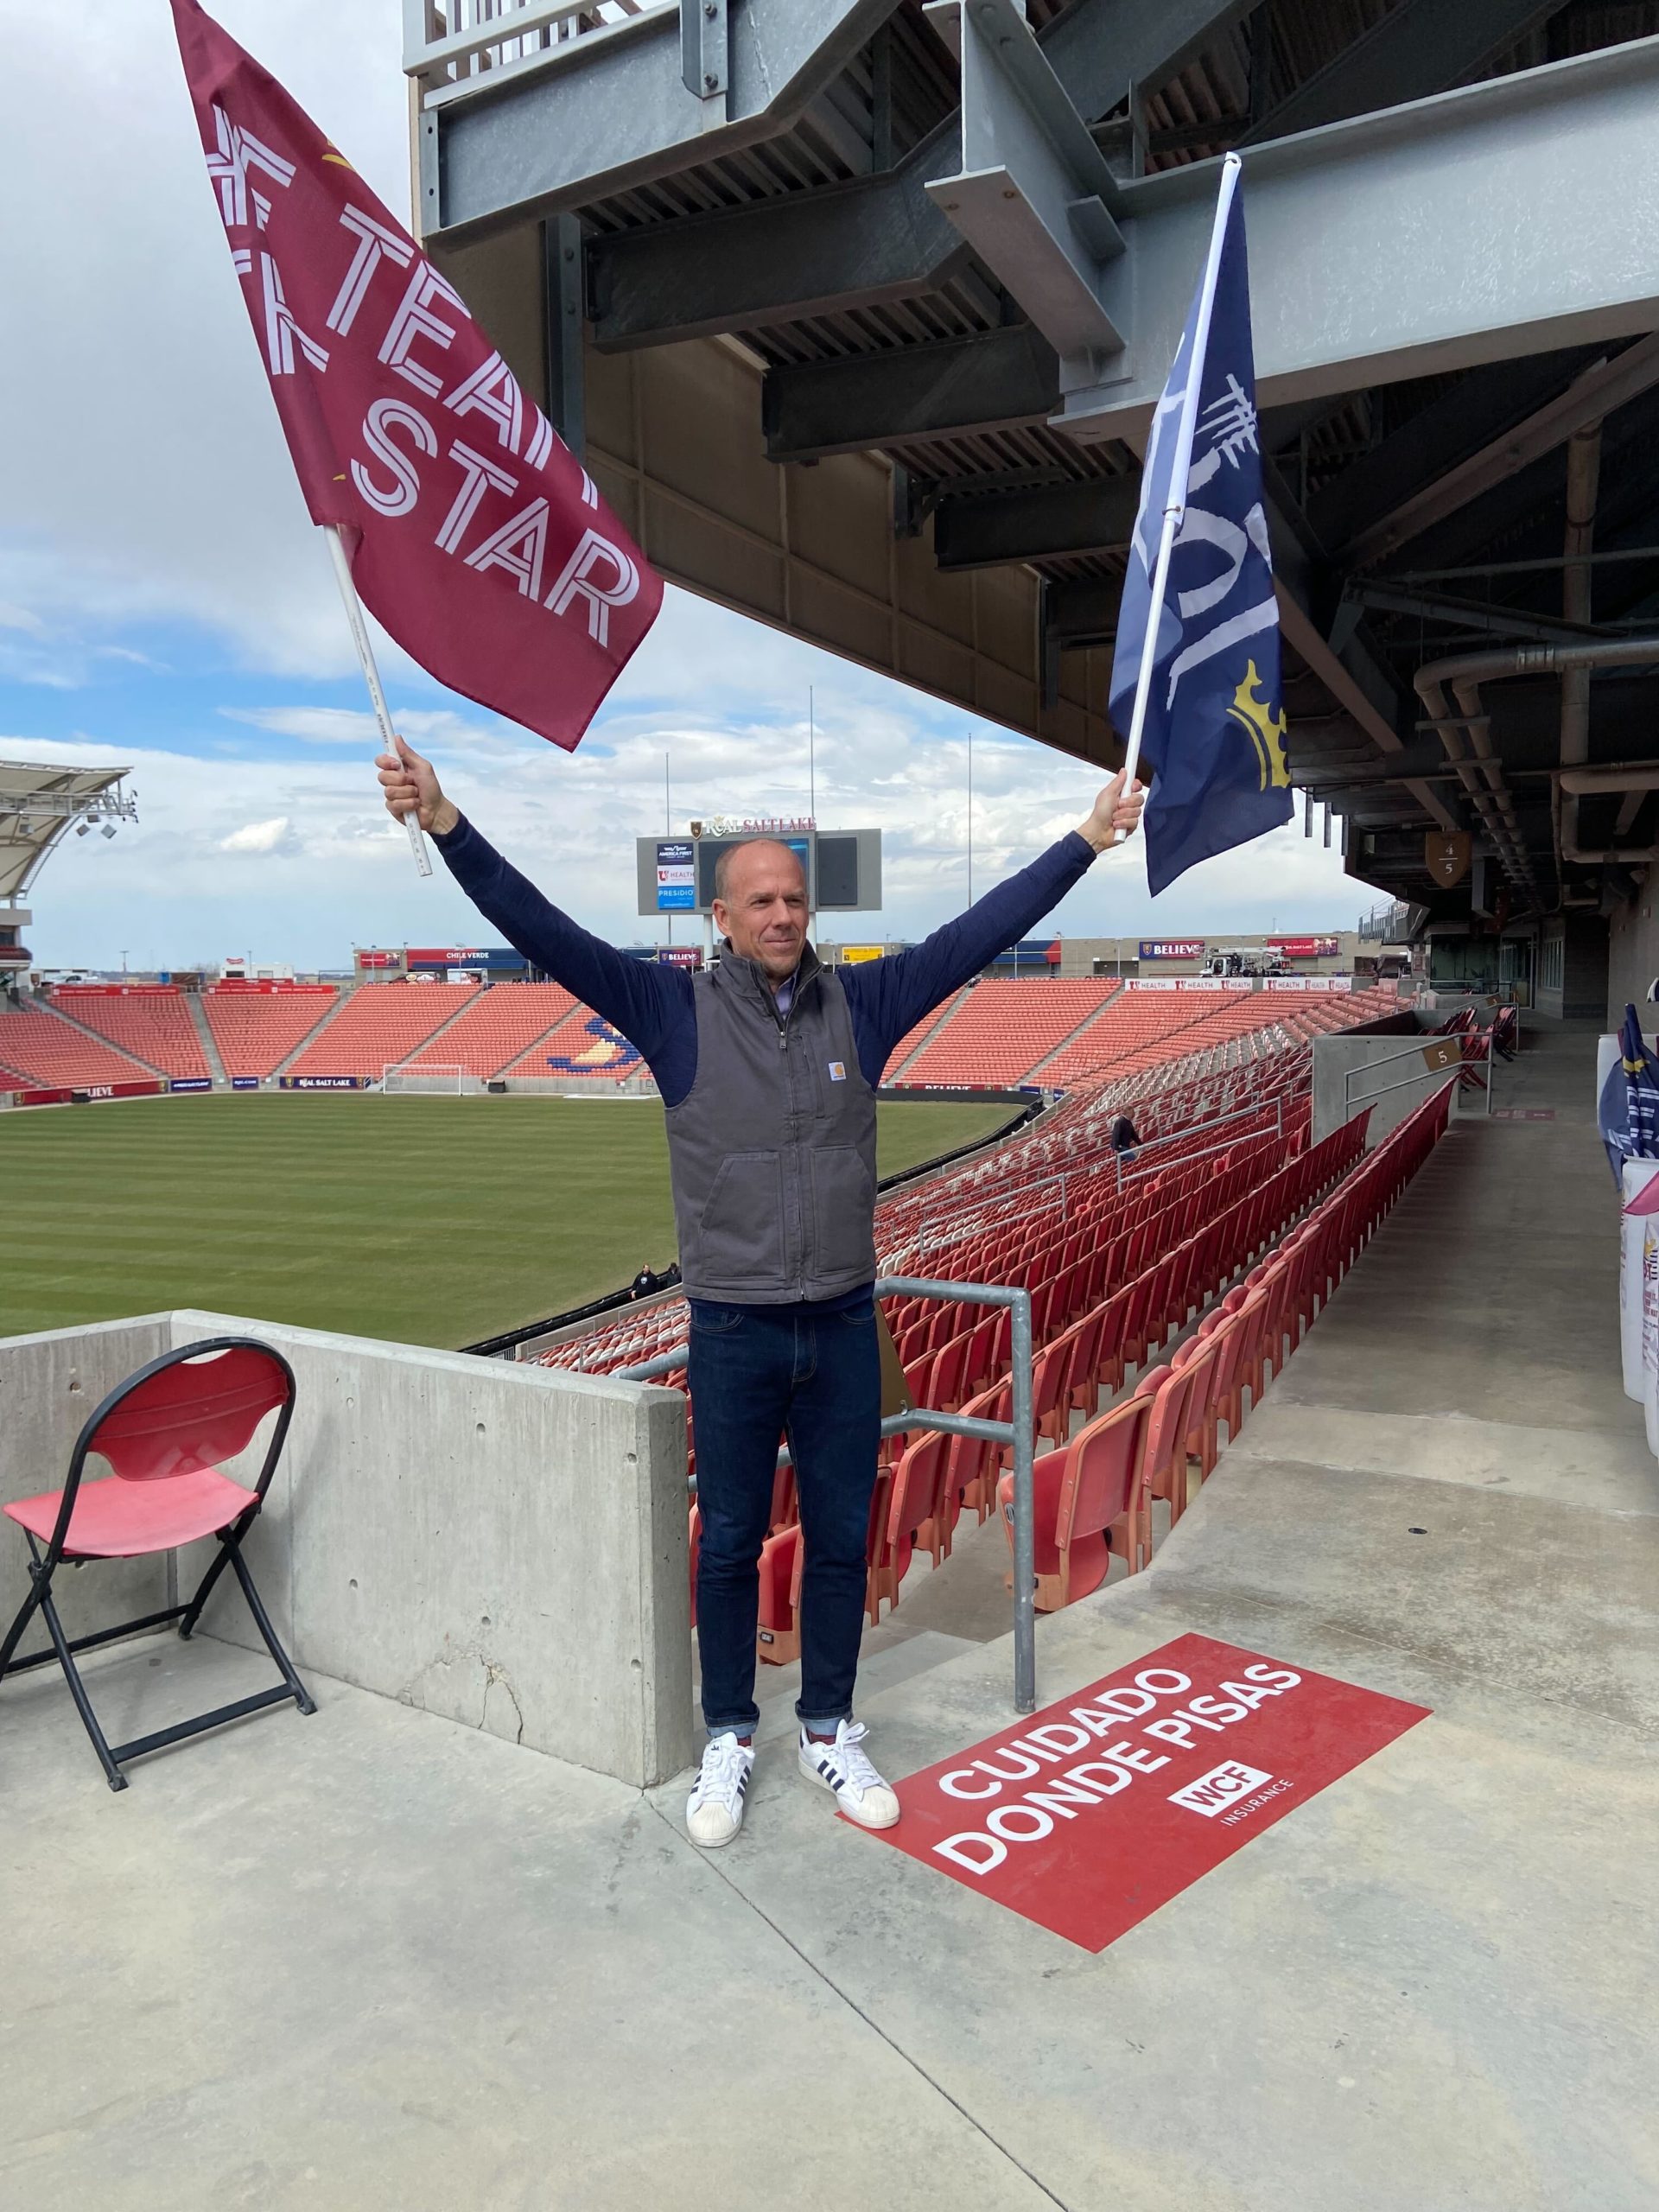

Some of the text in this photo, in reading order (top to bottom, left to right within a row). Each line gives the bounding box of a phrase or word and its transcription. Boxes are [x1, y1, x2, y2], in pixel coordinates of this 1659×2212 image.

[1194, 373, 1260, 469] THE
[351, 398, 640, 648] STAR
[743, 818, 775, 832] SALT
[777, 817, 816, 831] LAKE
[1446, 843, 1453, 855] 4
[1445, 862, 1452, 874] 5
[1154, 944, 1200, 955] BELIEVE
[1438, 1050, 1447, 1063] 5
[87, 1085, 114, 1097] LIEVE
[939, 1669, 1192, 1800] CUIDADO
[931, 1663, 1302, 1875] DONDE PISAS
[1181, 1765, 1253, 1808] WCF
[1220, 1778, 1294, 1827] INSURANCE
